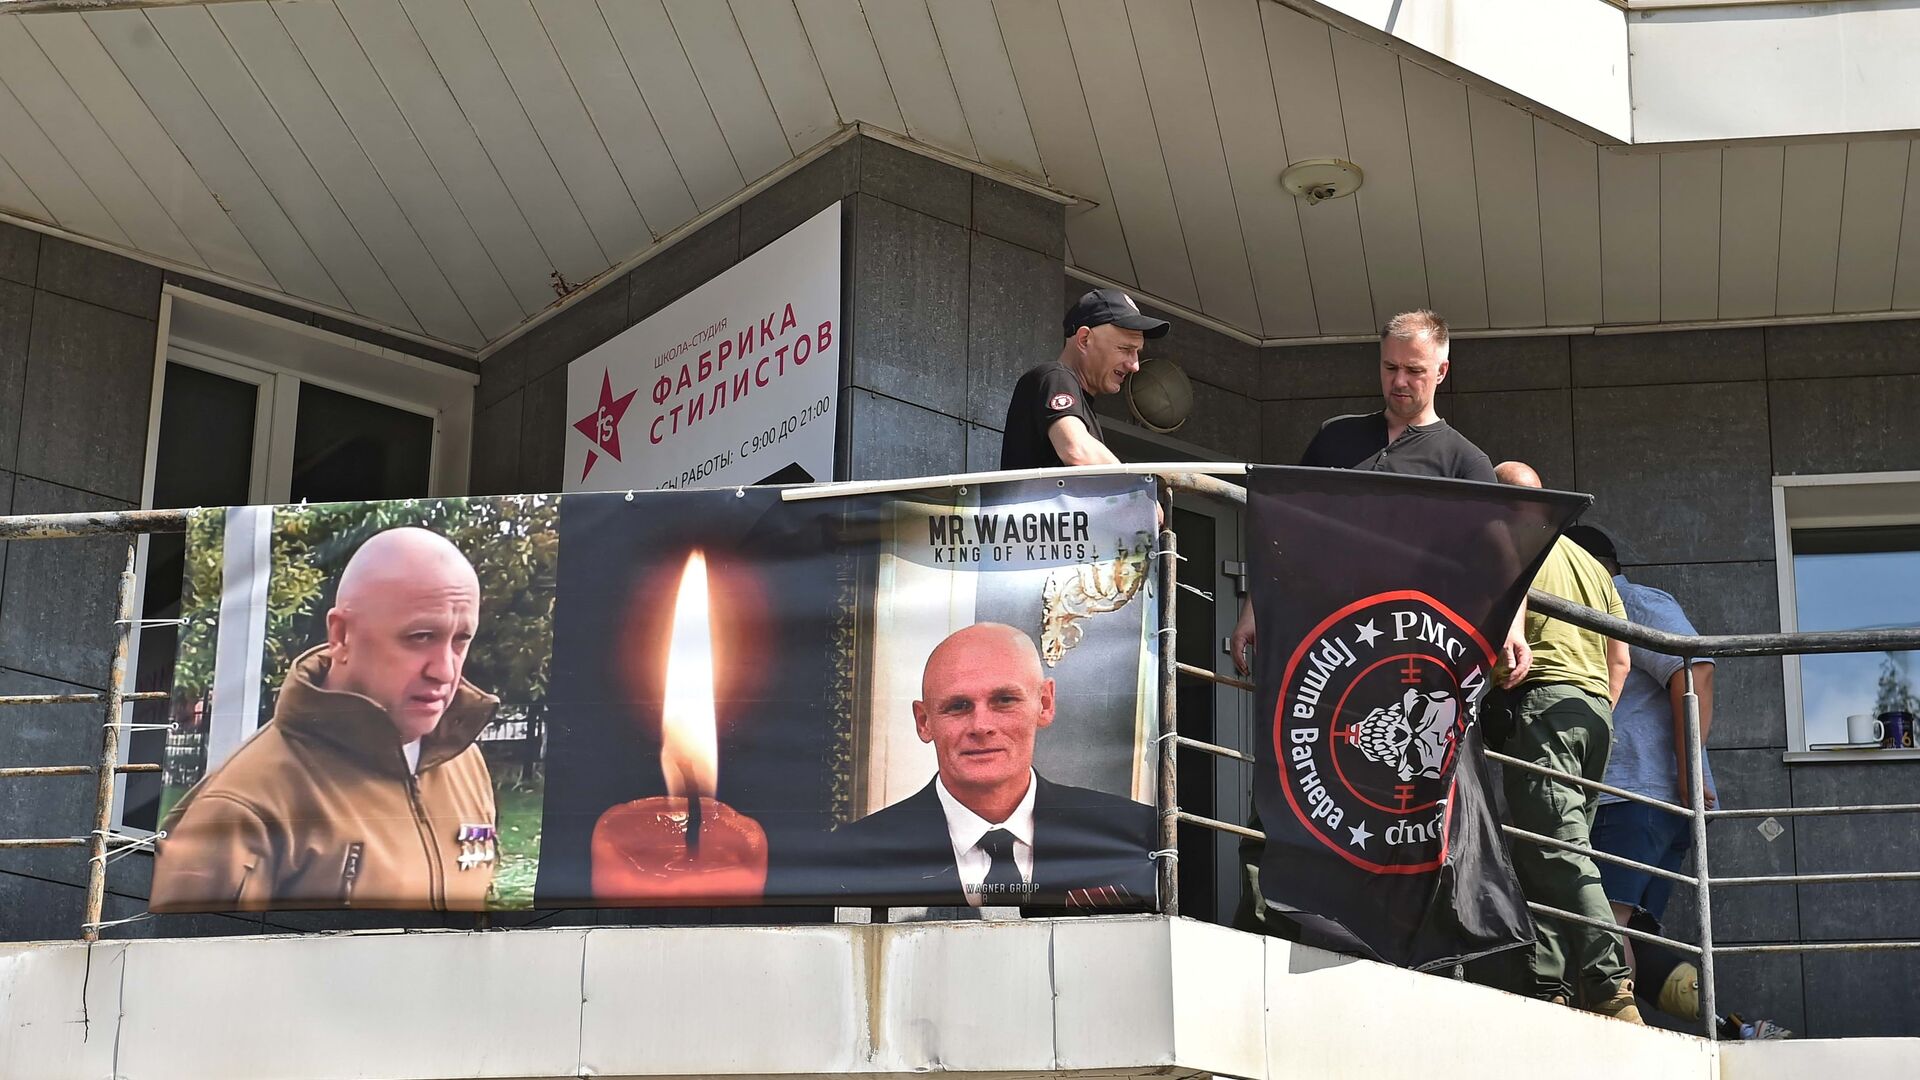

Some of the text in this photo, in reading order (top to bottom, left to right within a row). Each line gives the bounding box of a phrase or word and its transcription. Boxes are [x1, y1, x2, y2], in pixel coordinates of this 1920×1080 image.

[652, 302, 798, 406] ФАБРИКА
[654, 317, 728, 369] ШКОЛА-СТУДИЯ
[649, 320, 833, 445] СТИЛИСТОВ
[681, 450, 734, 488] РАБОТЫ:
[740, 440, 749, 458] С
[752, 427, 776, 453] 9:00
[778, 415, 798, 443] ДО
[800, 395, 830, 427] 21:00
[935, 543, 1085, 563] KING OF KINGS
[1390, 610, 1466, 665] PMC
[1290, 636, 1358, 830] Группа Вагнера
[965, 883, 1040, 894] WAGNER GROUP
